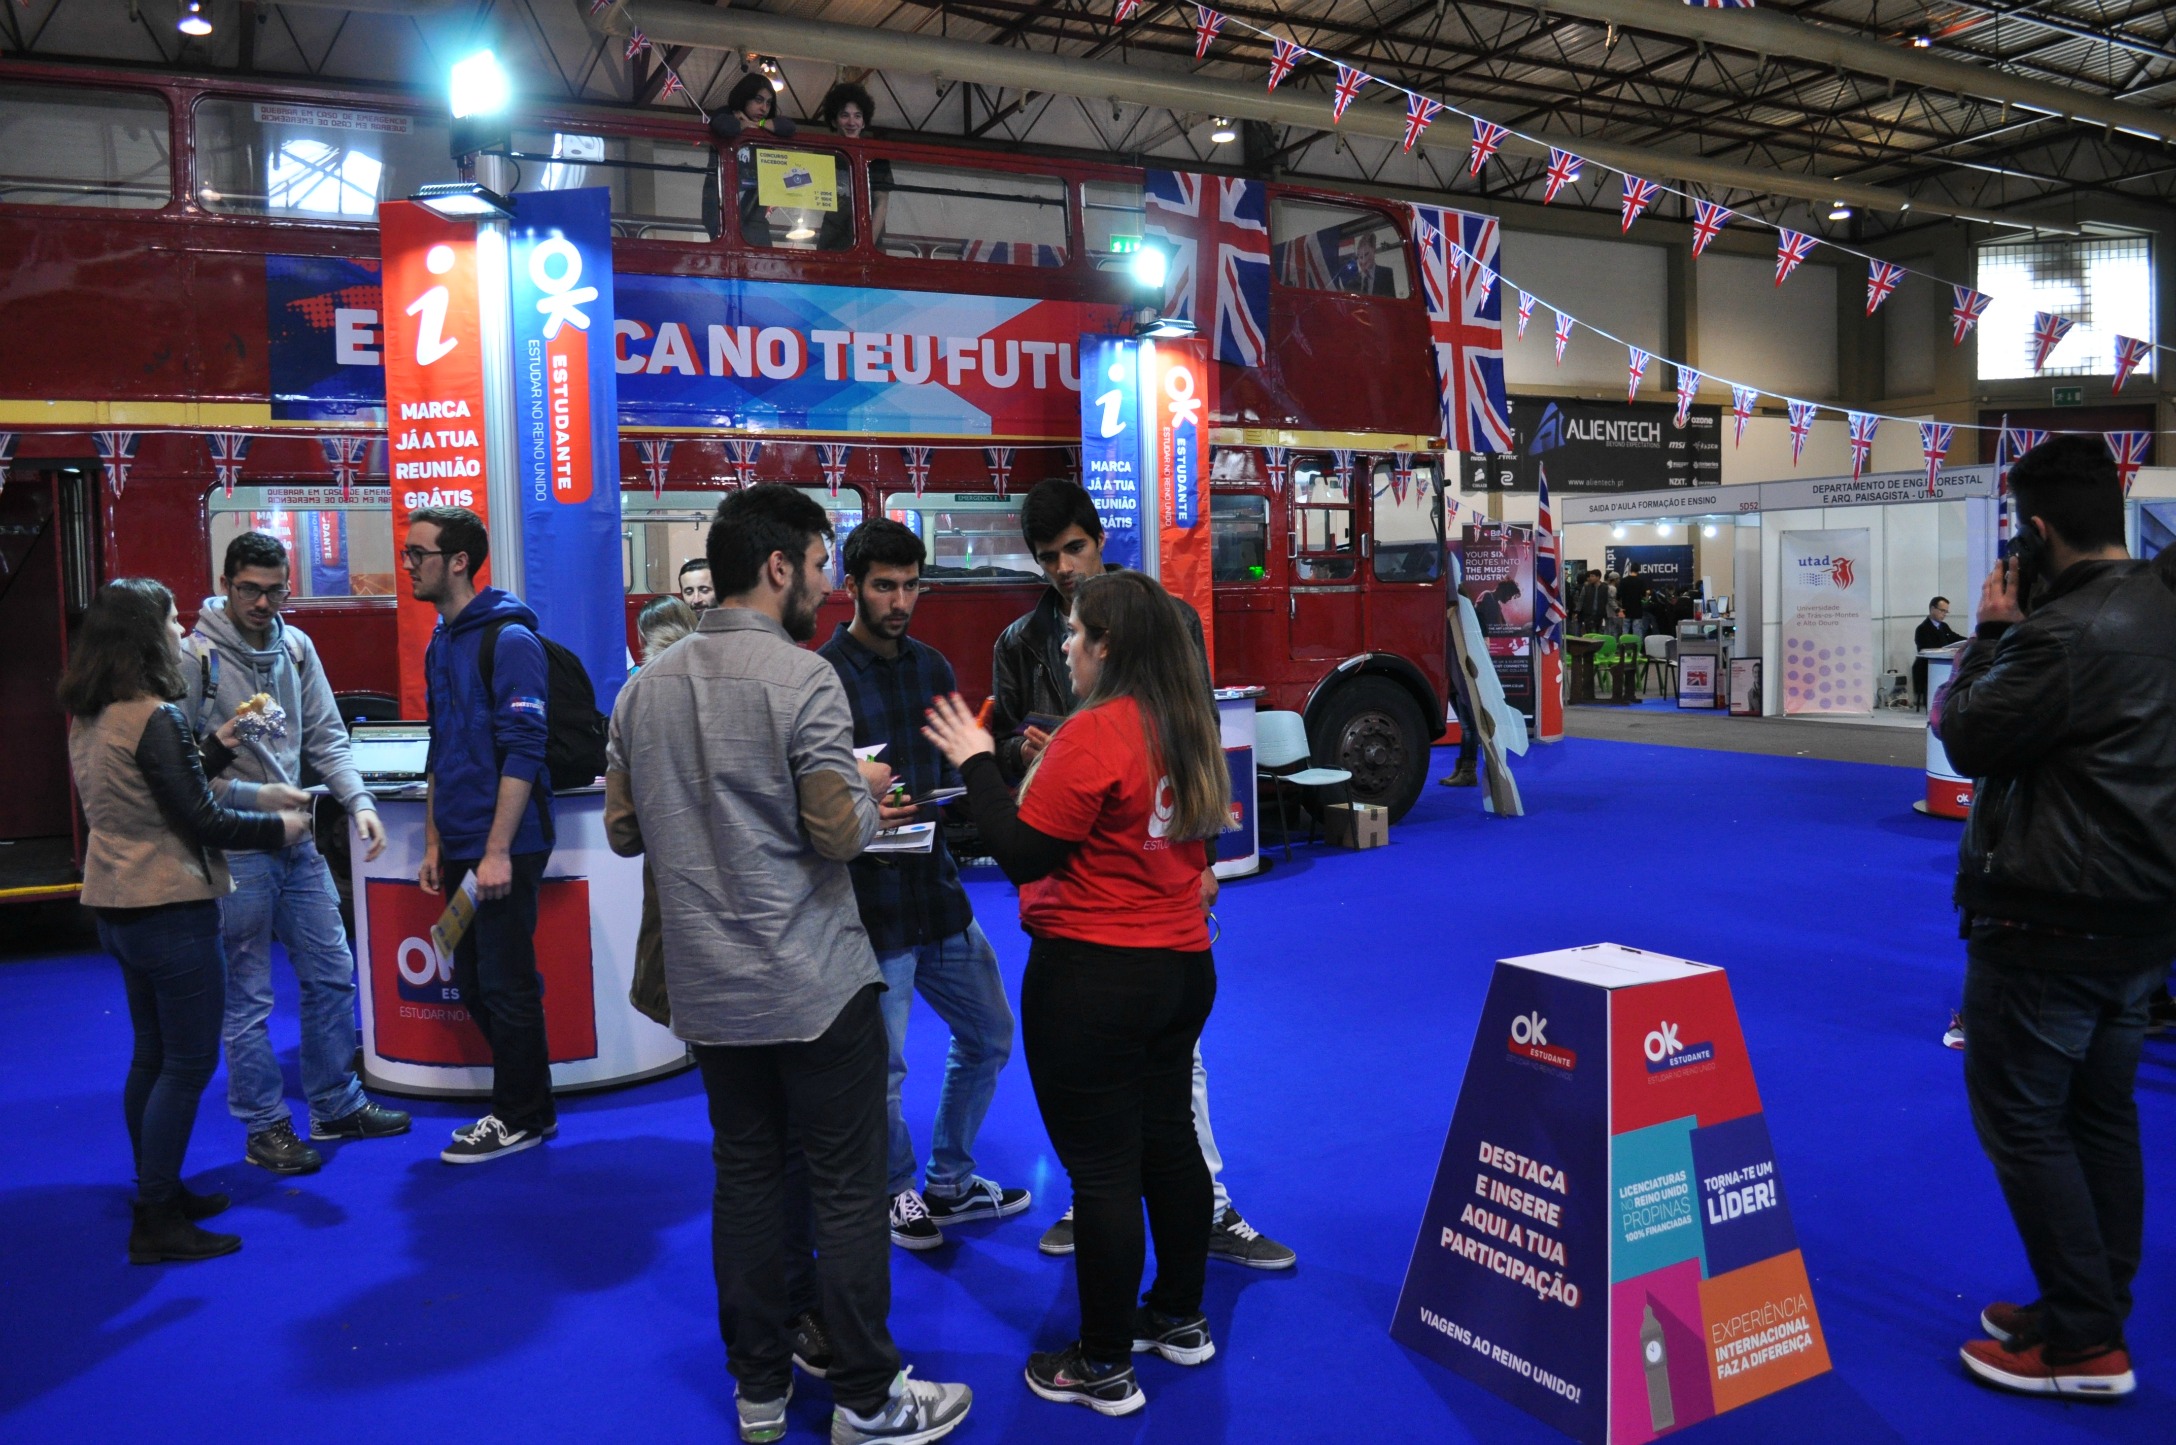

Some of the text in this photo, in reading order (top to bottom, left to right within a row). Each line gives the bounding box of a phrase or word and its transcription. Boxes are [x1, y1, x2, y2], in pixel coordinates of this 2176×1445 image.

[261, 106, 298, 115] QUEBRAR
[301, 109, 313, 117] EM
[317, 111, 338, 119] CASO
[357, 114, 407, 125] EMERGENCIA
[708, 324, 800, 379] NO
[811, 329, 932, 385] TEU
[947, 337, 1081, 391] FUTU
[401, 400, 471, 420] MARCA
[528, 339, 547, 501] ESTUDAR NO REINO UNIDO
[553, 355, 571, 490] ESTUDANTE
[1566, 419, 1661, 442] ALIENTECH
[396, 429, 479, 450] JÁ A TUA
[396, 456, 480, 479] REUNIÃO
[1091, 461, 1131, 472] MARCA
[1164, 466, 1171, 477] NO
[1088, 477, 1135, 491] JÁ A TUA
[1164, 479, 1172, 501] REINO
[1177, 438, 1187, 520] ESTUDANTE
[1813, 481, 1885, 494] DEPARTAMENTO
[1887, 479, 1900, 489] DE
[267, 488, 304, 496] QUEBRAR
[308, 488, 320, 496] EM
[364, 488, 391, 496] EMERG
[404, 488, 474, 509] GRÁTIS
[1638, 498, 1679, 509] FORMAÇÃO
[1681, 498, 1686, 506] E
[1687, 496, 1717, 506] ENSINO
[1823, 495, 1828, 503] E
[1831, 494, 1853, 504] ARQ.
[1855, 491, 1909, 501] PAISAGISTA
[1165, 503, 1173, 527] UNIDO
[1739, 502, 1758, 511] 5D52
[1099, 515, 1132, 528] RÁTIS
[322, 517, 332, 559] DANTE
[1798, 556, 1830, 567] utad
[400, 1006, 445, 1020] ESTUDAR
[448, 1010, 464, 1021] NO
[1530, 1048, 1571, 1067] ESTUDANTE
[1669, 1050, 1711, 1066] ESTUDANTE
[1478, 1141, 1567, 1194] DESTACA
[1704, 1161, 1773, 1192] TORNA-TE UM
[1619, 1170, 1686, 1198] LICENCIATURAS
[1475, 1174, 1561, 1227] E INSERE
[1620, 1184, 1688, 1212] NO REINO UNIDO
[1707, 1178, 1776, 1225] LÍDER!
[1622, 1196, 1691, 1231] PROPINAS
[1460, 1203, 1565, 1267] AQUI A TUA
[1625, 1214, 1692, 1242] 100% FINANCIADAS
[1440, 1227, 1579, 1308] PARTICIPAÇÃO
[1711, 1293, 1808, 1344] EXPERIÊNCIA
[1715, 1316, 1810, 1362] INTERNACIONAL
[1420, 1307, 1581, 1403] VIAGENS AO REINO UNIDO!
[1717, 1332, 1813, 1380] FAZ A DIFERENÇA
